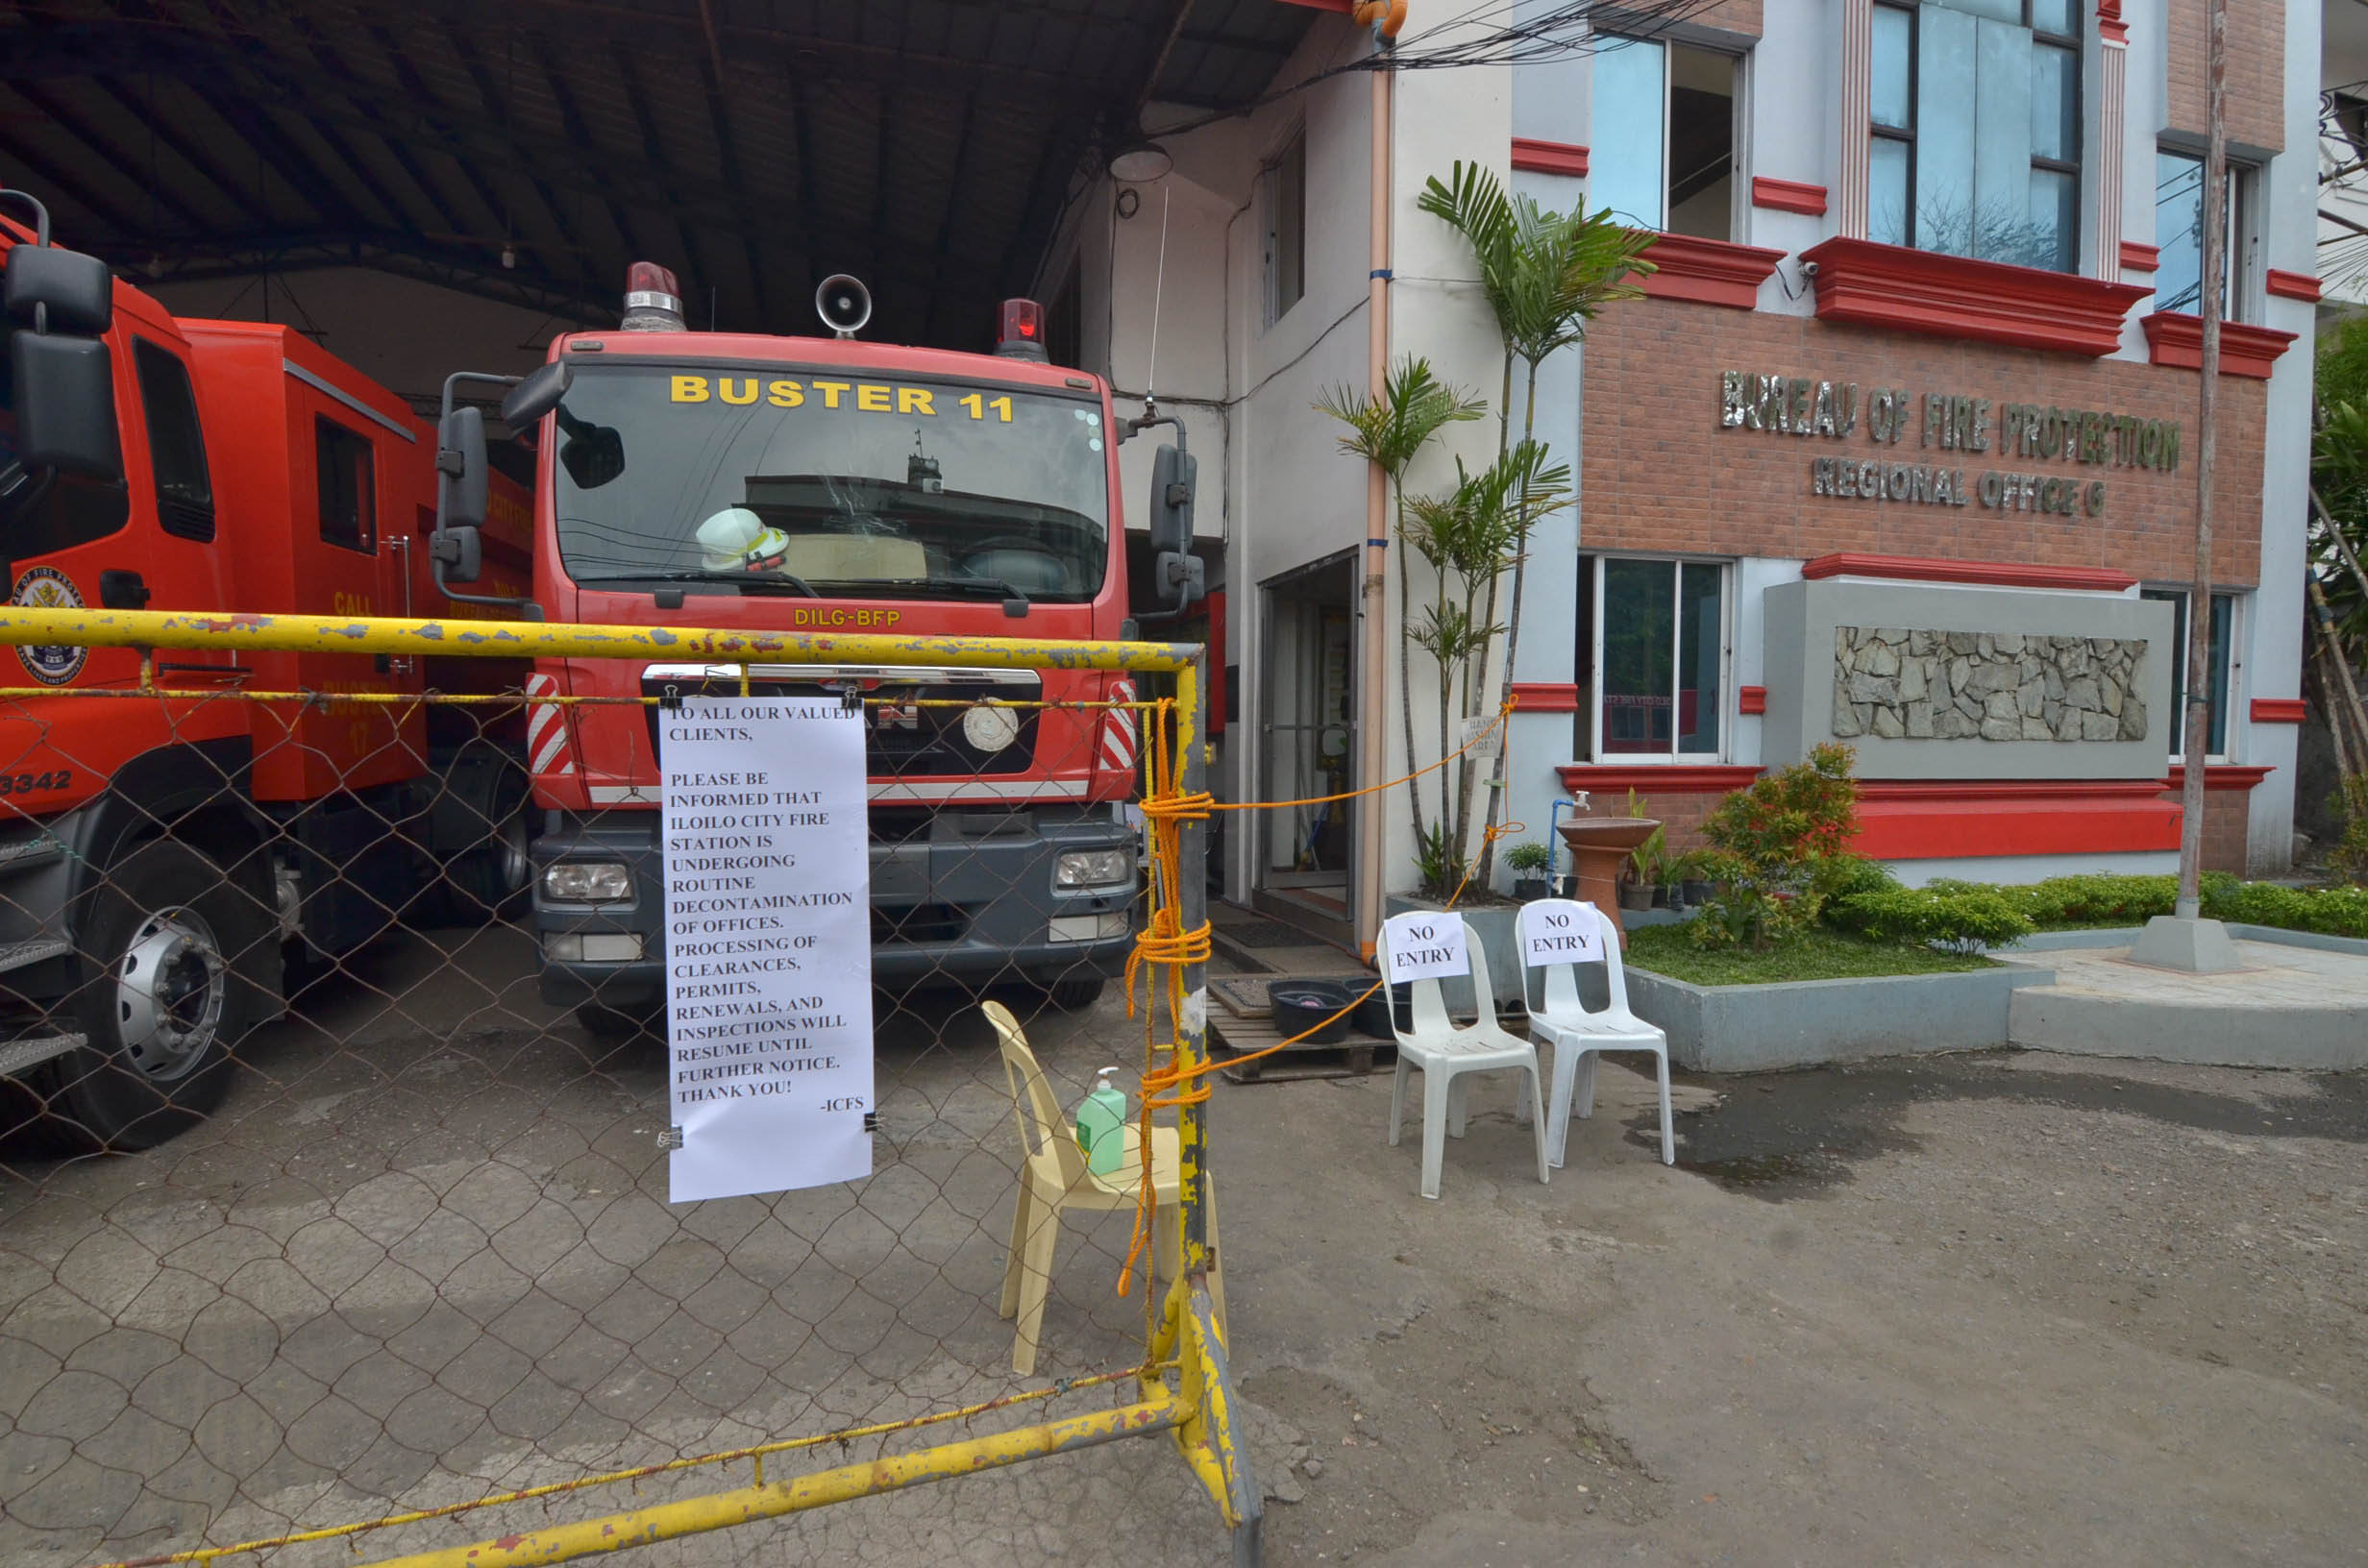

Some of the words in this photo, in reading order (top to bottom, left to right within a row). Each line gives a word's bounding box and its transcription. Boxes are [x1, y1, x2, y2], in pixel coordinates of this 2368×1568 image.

[670, 375, 938, 416] BUSTER
[959, 393, 1013, 423] 11
[1722, 371, 1857, 438] BUREAU
[1868, 386, 1911, 444] OF
[1922, 392, 1991, 451] FIRE
[2001, 403, 2182, 470] PROTECTION
[1813, 458, 1970, 506] REGIONAL
[1978, 470, 2079, 515] OFFICE
[2085, 481, 2106, 516] 6
[34, 568, 54, 577] FIRE
[794, 609, 900, 626] DILG-BFP
[670, 707, 694, 721] TO
[700, 707, 736, 720] ALL
[741, 707, 779, 720] OUR
[784, 707, 854, 720] VALUED
[670, 727, 752, 742] CLIENTS,
[672, 773, 740, 787] PLEASE
[746, 772, 769, 784] BE
[671, 793, 769, 808] INFORMED
[774, 792, 822, 804] THAT
[672, 817, 736, 830] ILOILO
[741, 815, 784, 828] CITY
[789, 813, 829, 825] FIRE
[671, 836, 752, 851] STATION
[757, 836, 773, 847] IS
[673, 855, 795, 871] UNDERGOING
[673, 877, 755, 893] ROUTINE
[674, 893, 853, 914] DECONTAMINATION
[674, 921, 698, 934] OF
[703, 917, 783, 932] OFFICES.
[1545, 914, 1569, 929] NO
[1409, 926, 1434, 942] NO
[675, 940, 789, 957] PROCESSING
[794, 936, 817, 947] OF
[1533, 935, 1590, 952] ENTRY
[1396, 947, 1454, 968] ENTRY
[675, 958, 801, 977] CLEARANCES,
[676, 981, 761, 999] PERMITS,
[677, 1000, 782, 1019] RENEWALS,
[788, 996, 823, 1010] AND
[677, 1018, 796, 1041] INSPECTIONS
[802, 1015, 847, 1029] WILL
[678, 1042, 753, 1062] RESUME
[759, 1038, 812, 1052] UNTIL
[678, 1063, 763, 1084] FURTHER
[769, 1057, 840, 1072] NOTICE.
[678, 1085, 742, 1103] THANK
[749, 1081, 791, 1095] YOU!
[820, 1097, 864, 1112] -ICFS
